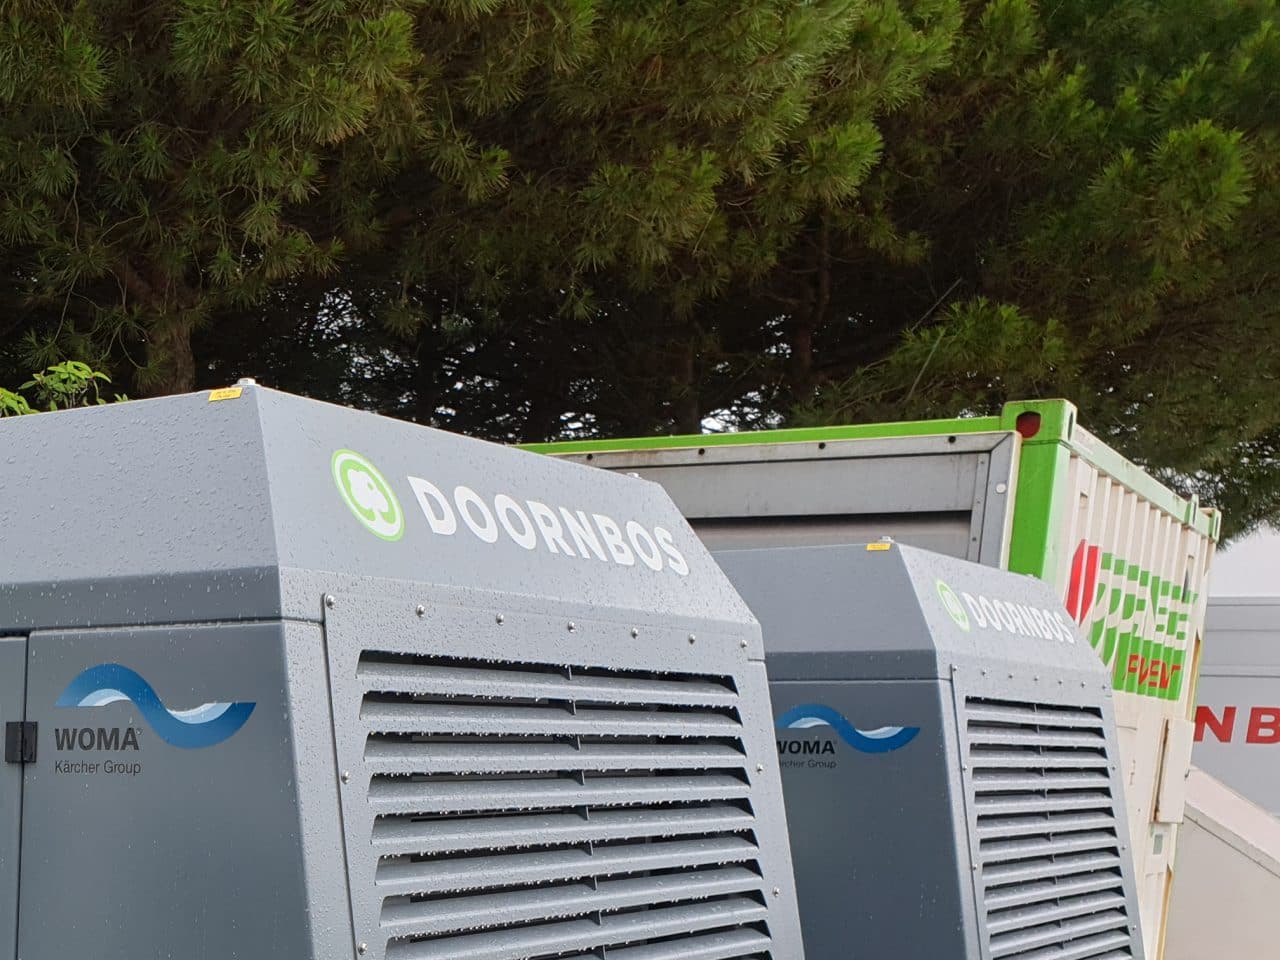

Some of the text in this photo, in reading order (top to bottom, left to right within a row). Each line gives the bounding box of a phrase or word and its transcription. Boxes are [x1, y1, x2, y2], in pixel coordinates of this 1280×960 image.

[407, 476, 690, 576] DOORNBOS
[961, 591, 1076, 644] DOORNBOS
[54, 726, 140, 751] WOMA
[54, 759, 142, 776] Kärcher Group
